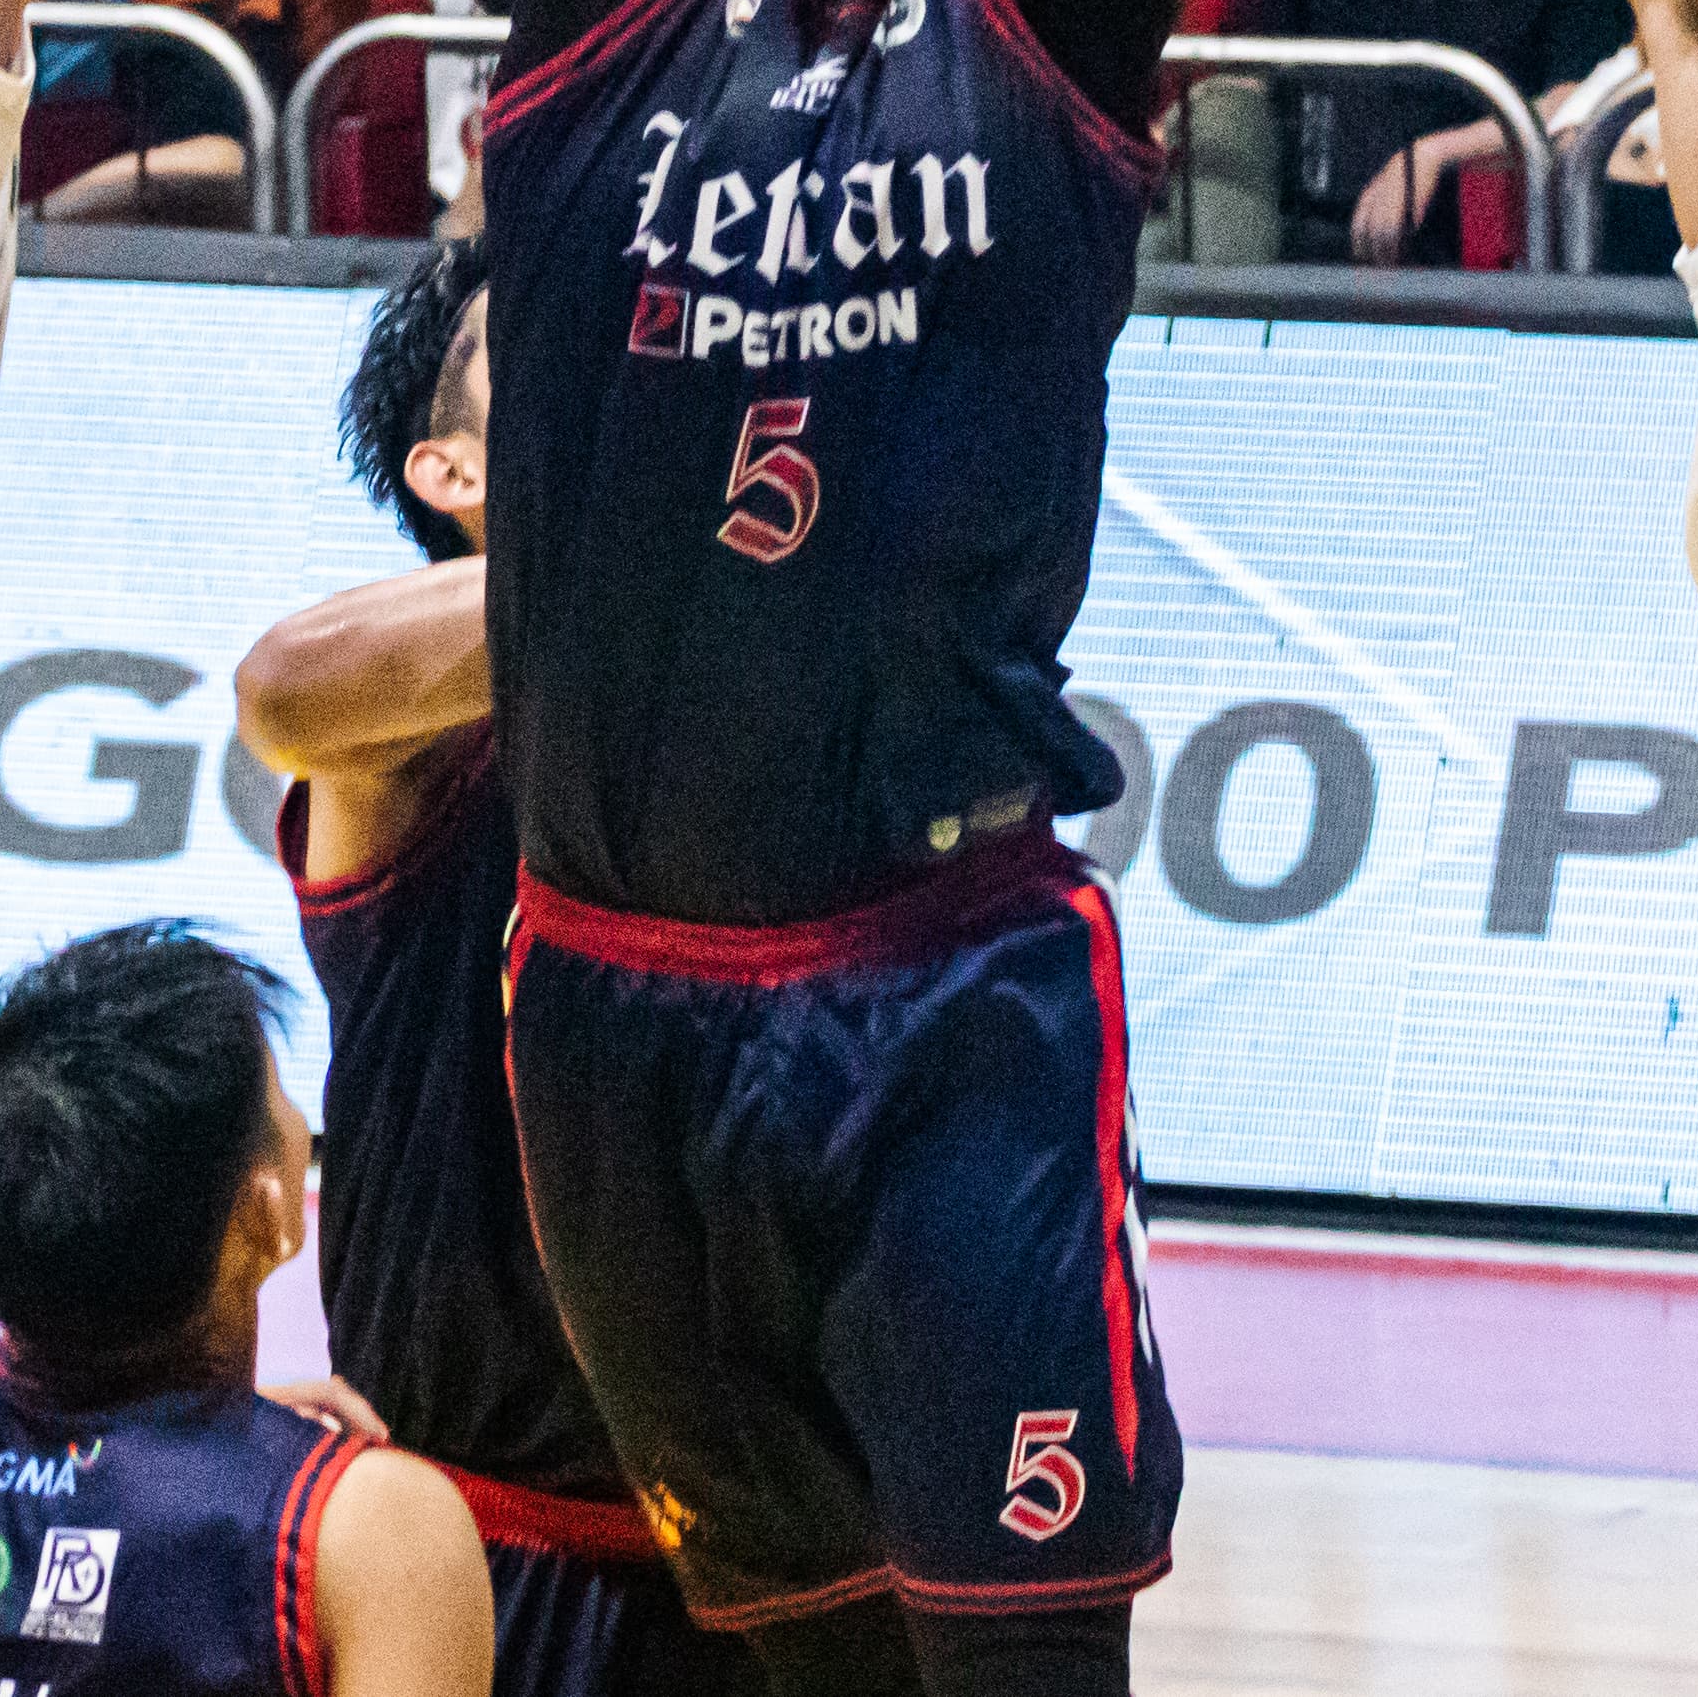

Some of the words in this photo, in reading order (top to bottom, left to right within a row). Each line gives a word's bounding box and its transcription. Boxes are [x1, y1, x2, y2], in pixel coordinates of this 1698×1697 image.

[623, 110, 995, 286] Letran
[691, 286, 919, 370] PETRON
[716, 396, 821, 564] 5
[998, 1408, 1087, 1542] 5
